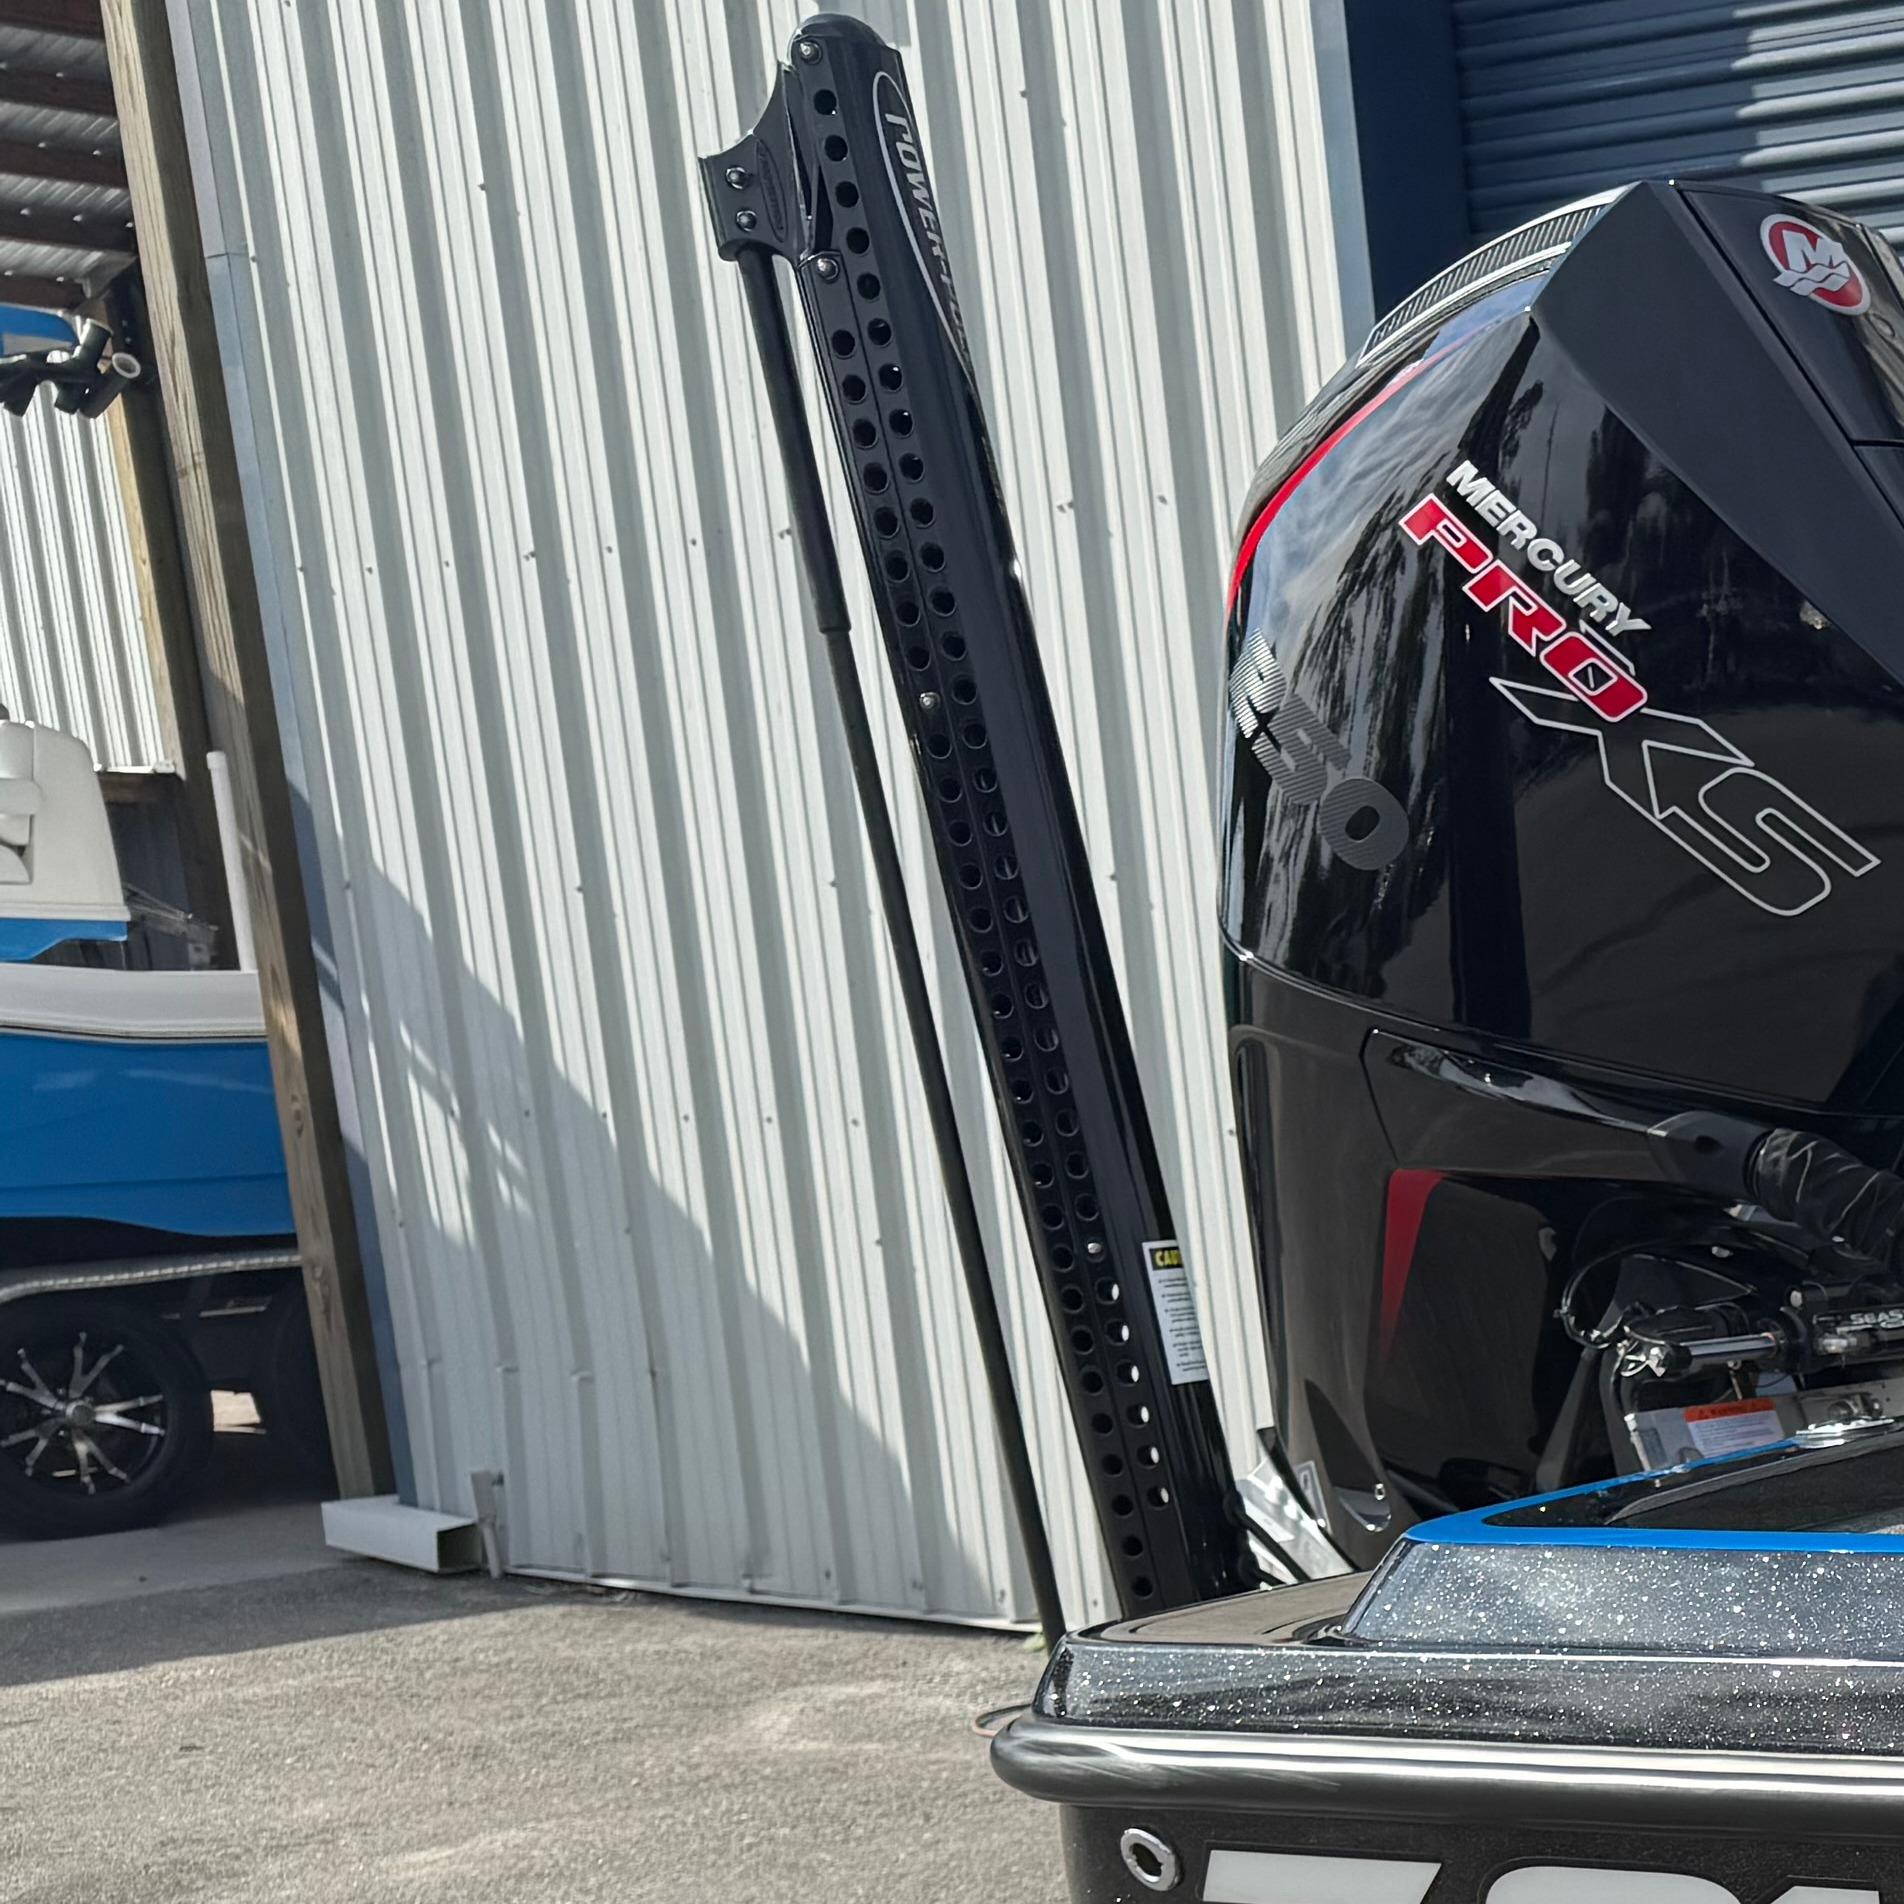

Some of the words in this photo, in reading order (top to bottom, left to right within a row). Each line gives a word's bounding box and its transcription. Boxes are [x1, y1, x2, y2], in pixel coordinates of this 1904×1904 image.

[1399, 493, 1648, 722] PRO
[1446, 460, 1652, 636] MERCURY
[1489, 619, 1881, 917] XS
